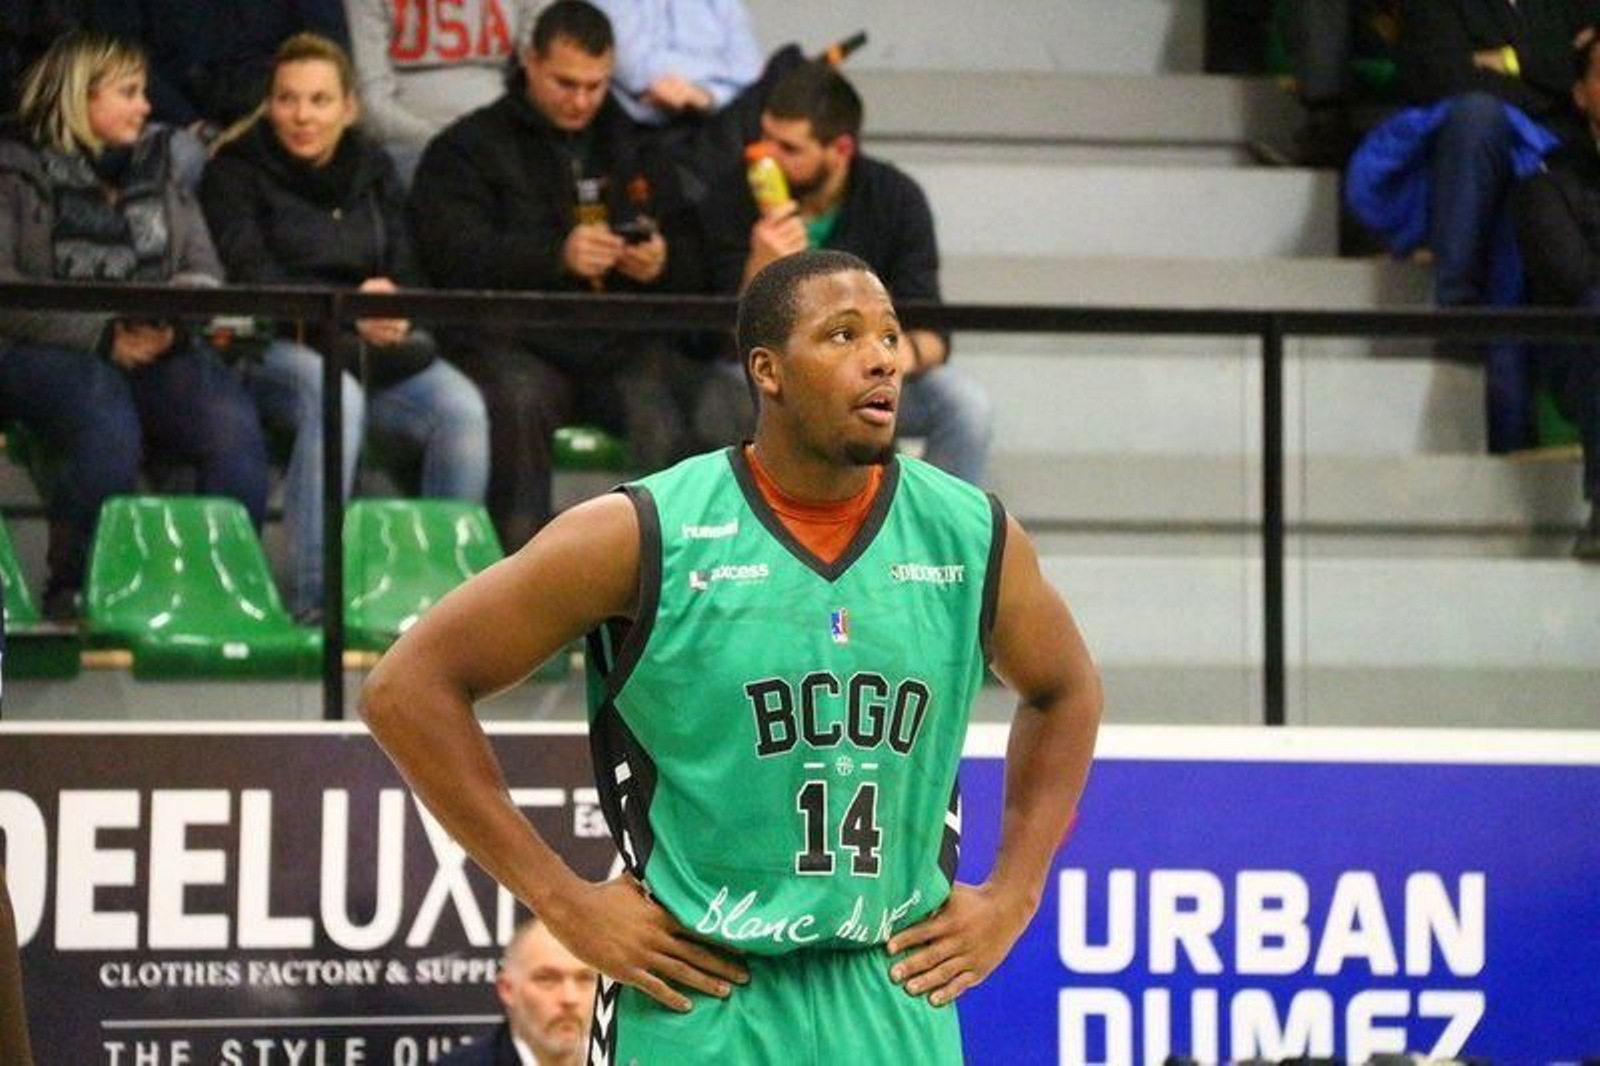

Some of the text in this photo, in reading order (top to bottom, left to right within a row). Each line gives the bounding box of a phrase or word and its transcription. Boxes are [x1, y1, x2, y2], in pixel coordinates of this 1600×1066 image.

[389, 0, 513, 61] USA
[744, 671, 931, 758] BCGO
[795, 780, 882, 877] 14
[0, 789, 566, 950] DEELUX
[696, 886, 820, 942] Blanc
[1058, 868, 1486, 976] URBAN
[100, 960, 241, 988] CLOTHES
[247, 958, 380, 986] FACTORY
[385, 960, 409, 983] &
[103, 1041, 191, 1066] THE
[220, 1037, 367, 1066] STYLE
[1058, 987, 1486, 1066] DUMEZ
